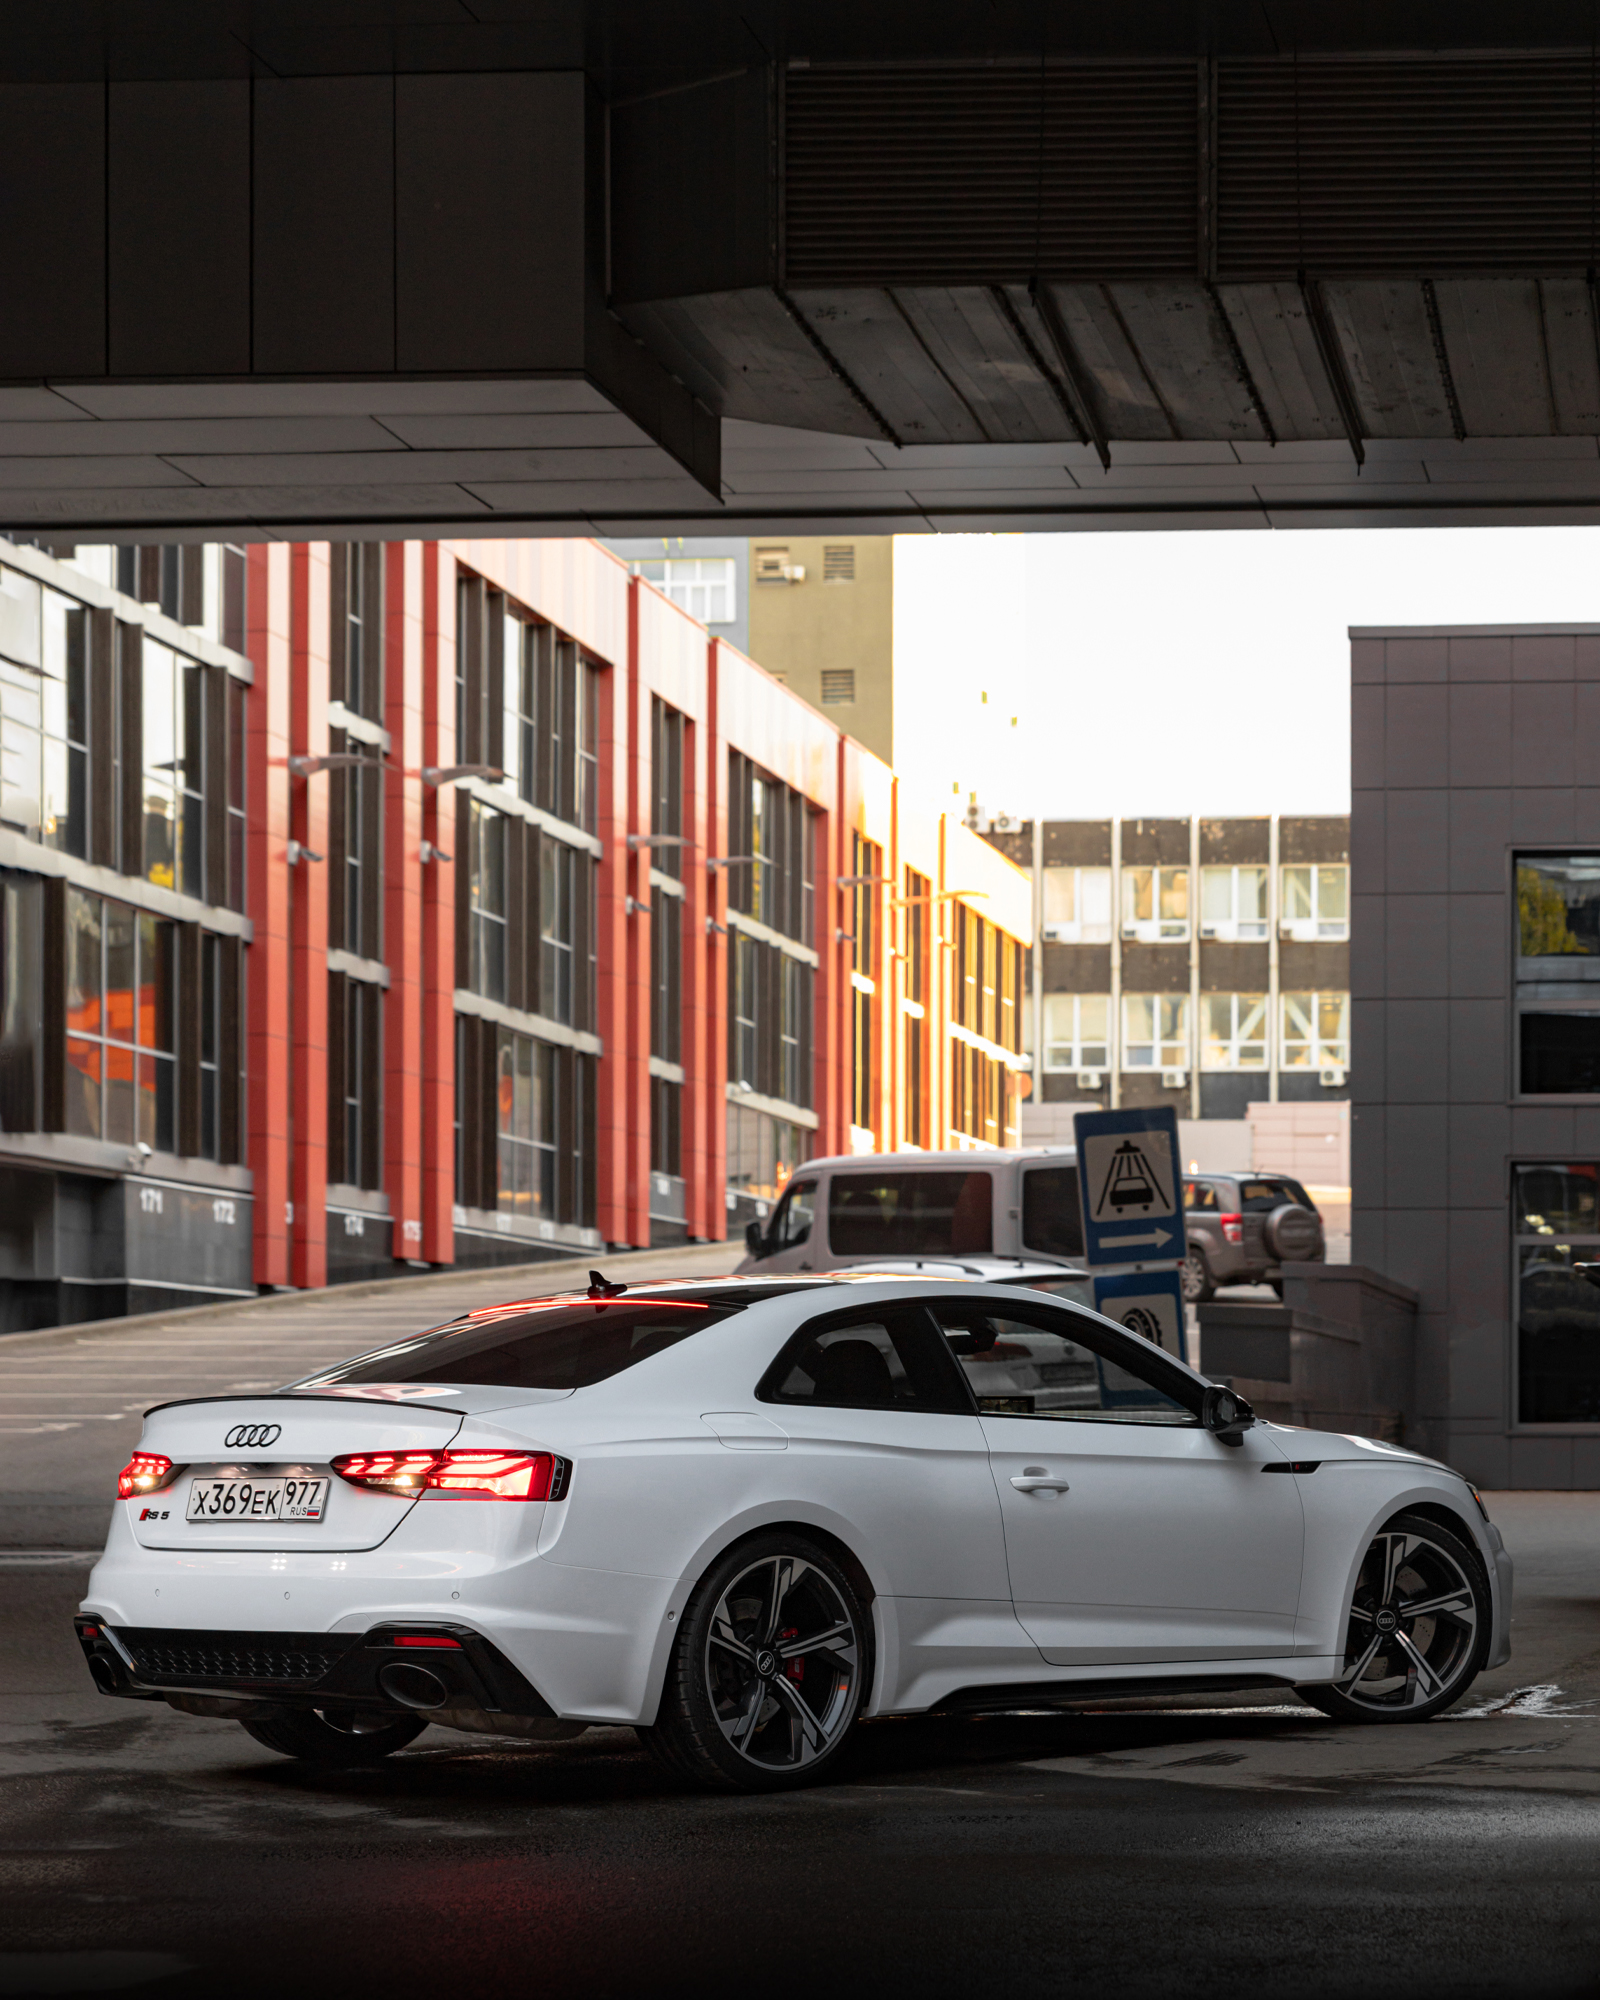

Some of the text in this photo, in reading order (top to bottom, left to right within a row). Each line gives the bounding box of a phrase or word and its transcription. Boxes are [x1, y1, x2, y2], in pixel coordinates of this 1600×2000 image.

[140, 1187, 163, 1214] 171
[213, 1199, 236, 1224] 172
[286, 1481, 321, 1505] 977
[139, 1508, 170, 1521] RS 5
[290, 1506, 307, 1516] RUS
